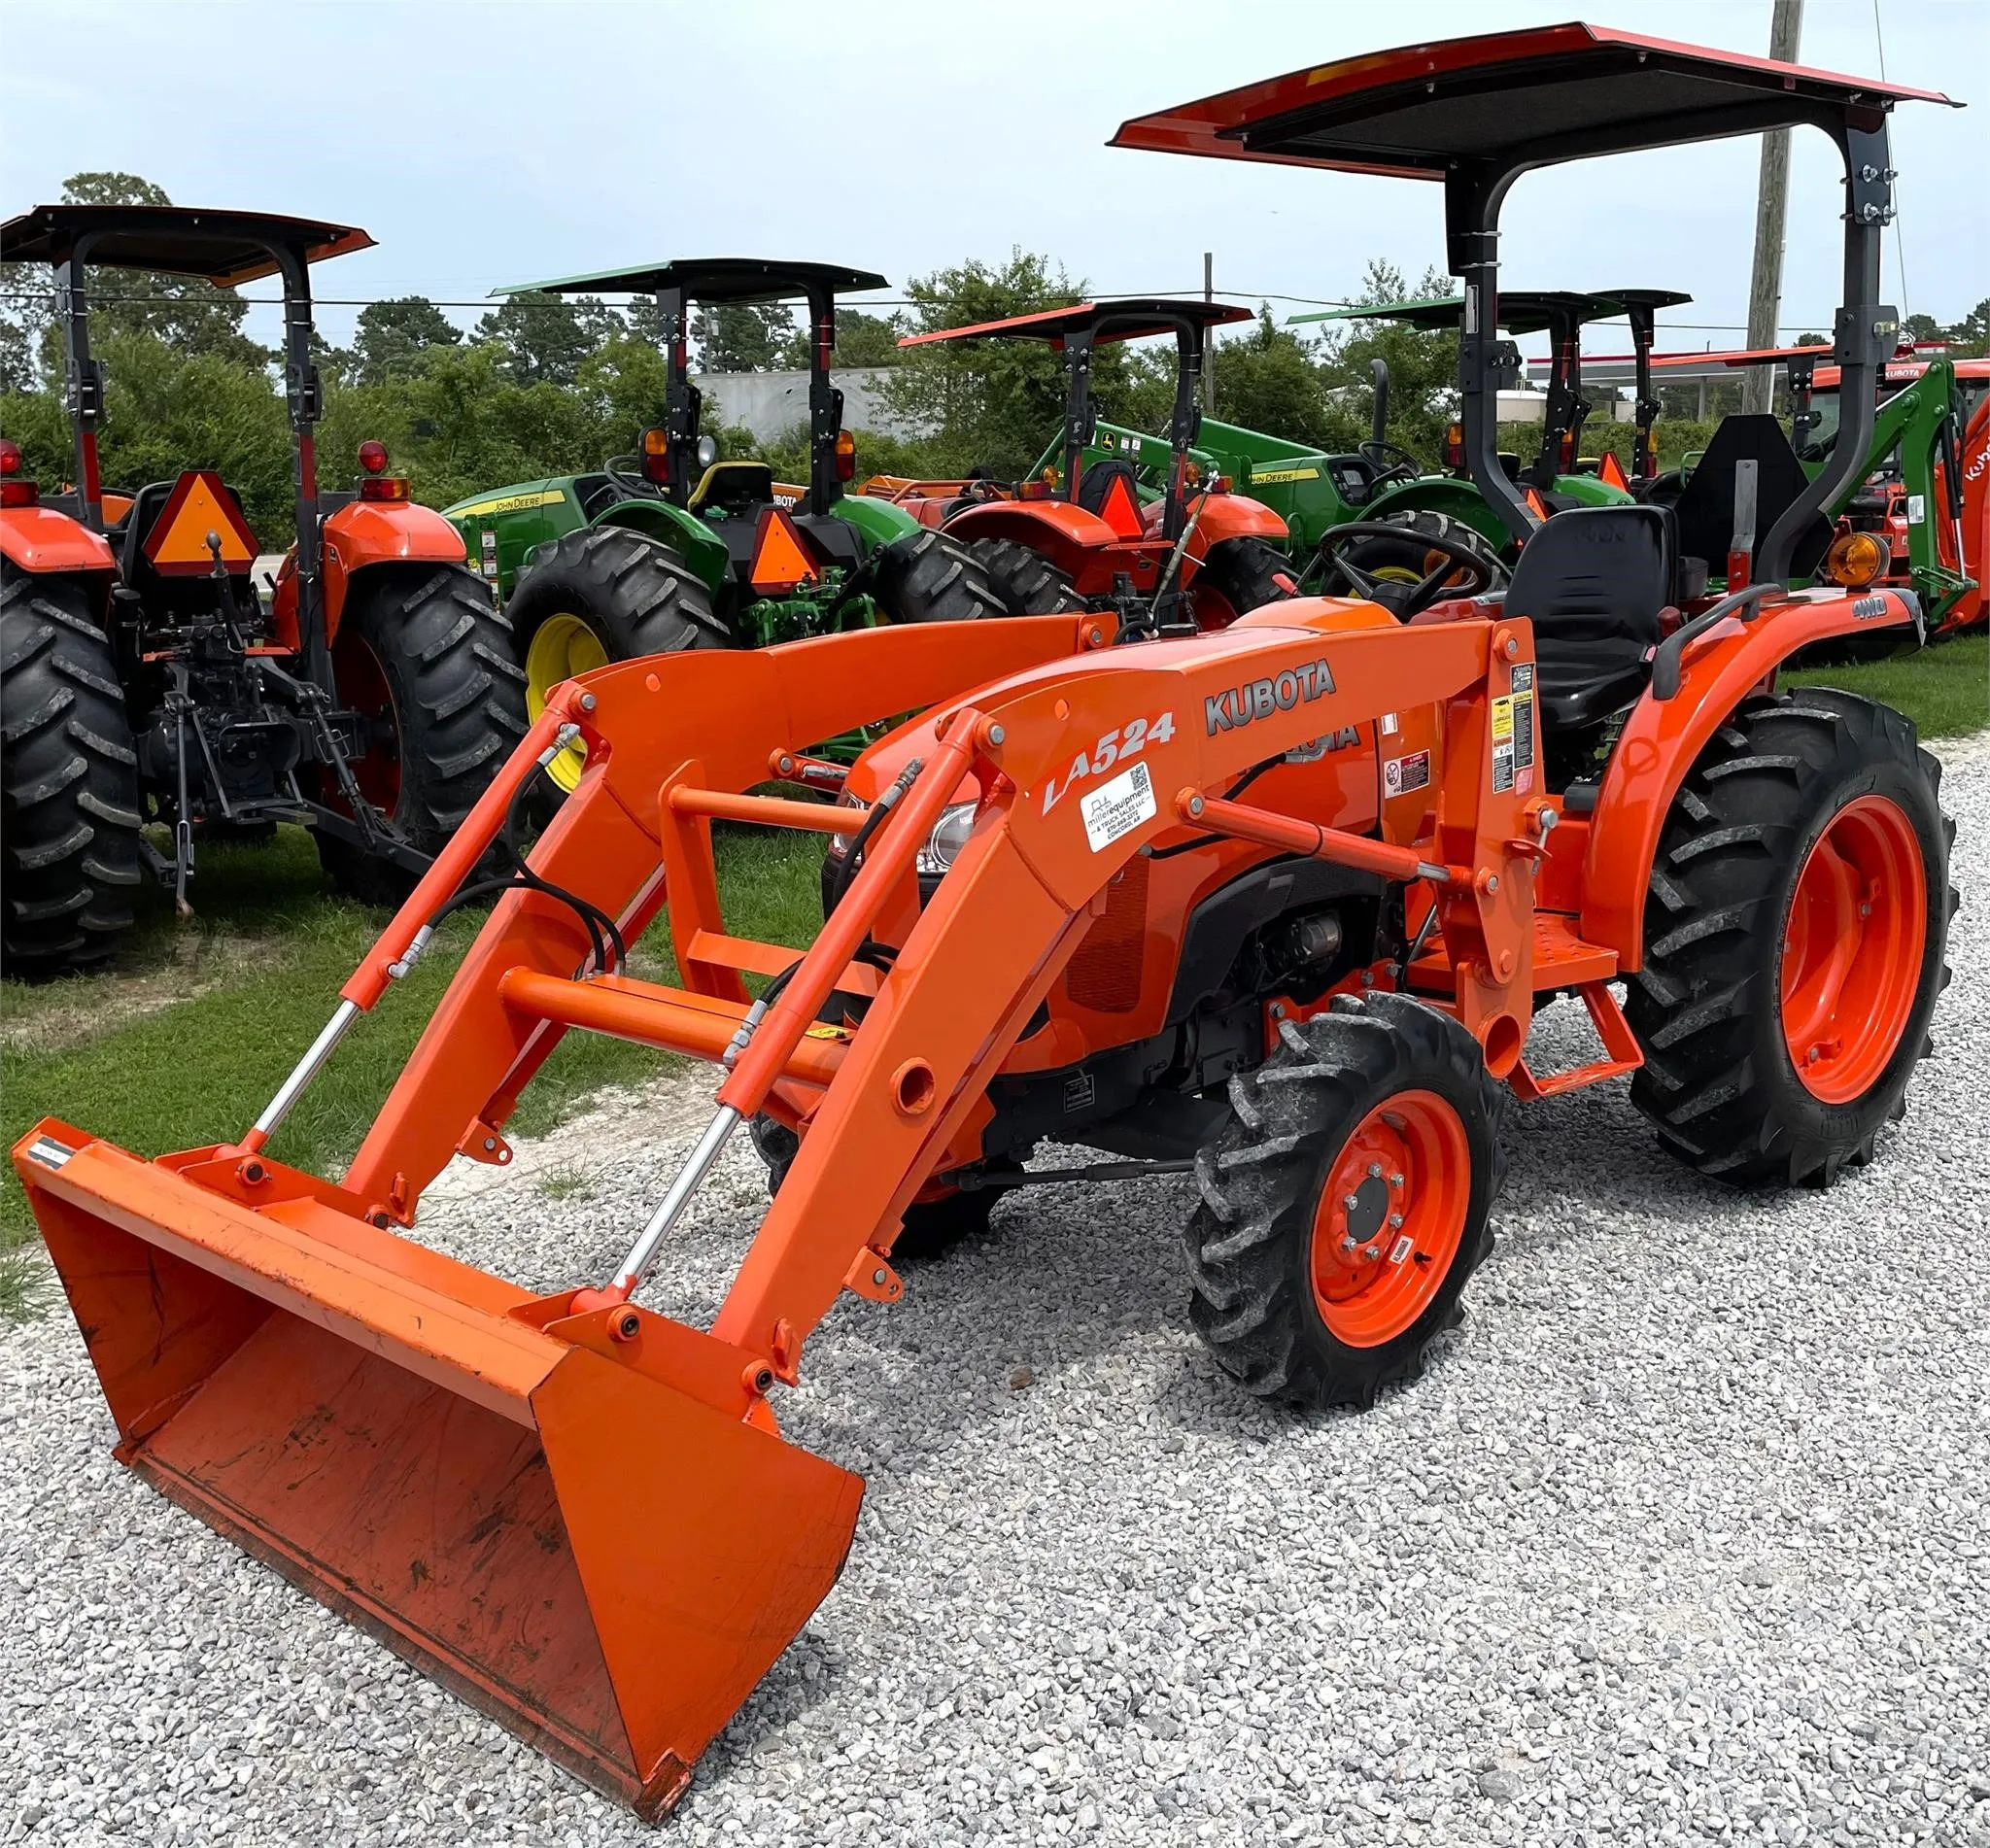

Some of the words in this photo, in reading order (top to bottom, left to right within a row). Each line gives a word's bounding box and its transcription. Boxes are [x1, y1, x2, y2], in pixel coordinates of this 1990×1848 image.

[1885, 369, 1920, 378] KUBOTA
[494, 501, 514, 512] JOHN
[514, 496, 540, 508] DEERE
[1852, 596, 1888, 620] 4WD
[1204, 658, 1337, 737] KUBOTA
[1042, 711, 1176, 817] LA524
[1118, 804, 1135, 817] SALES
